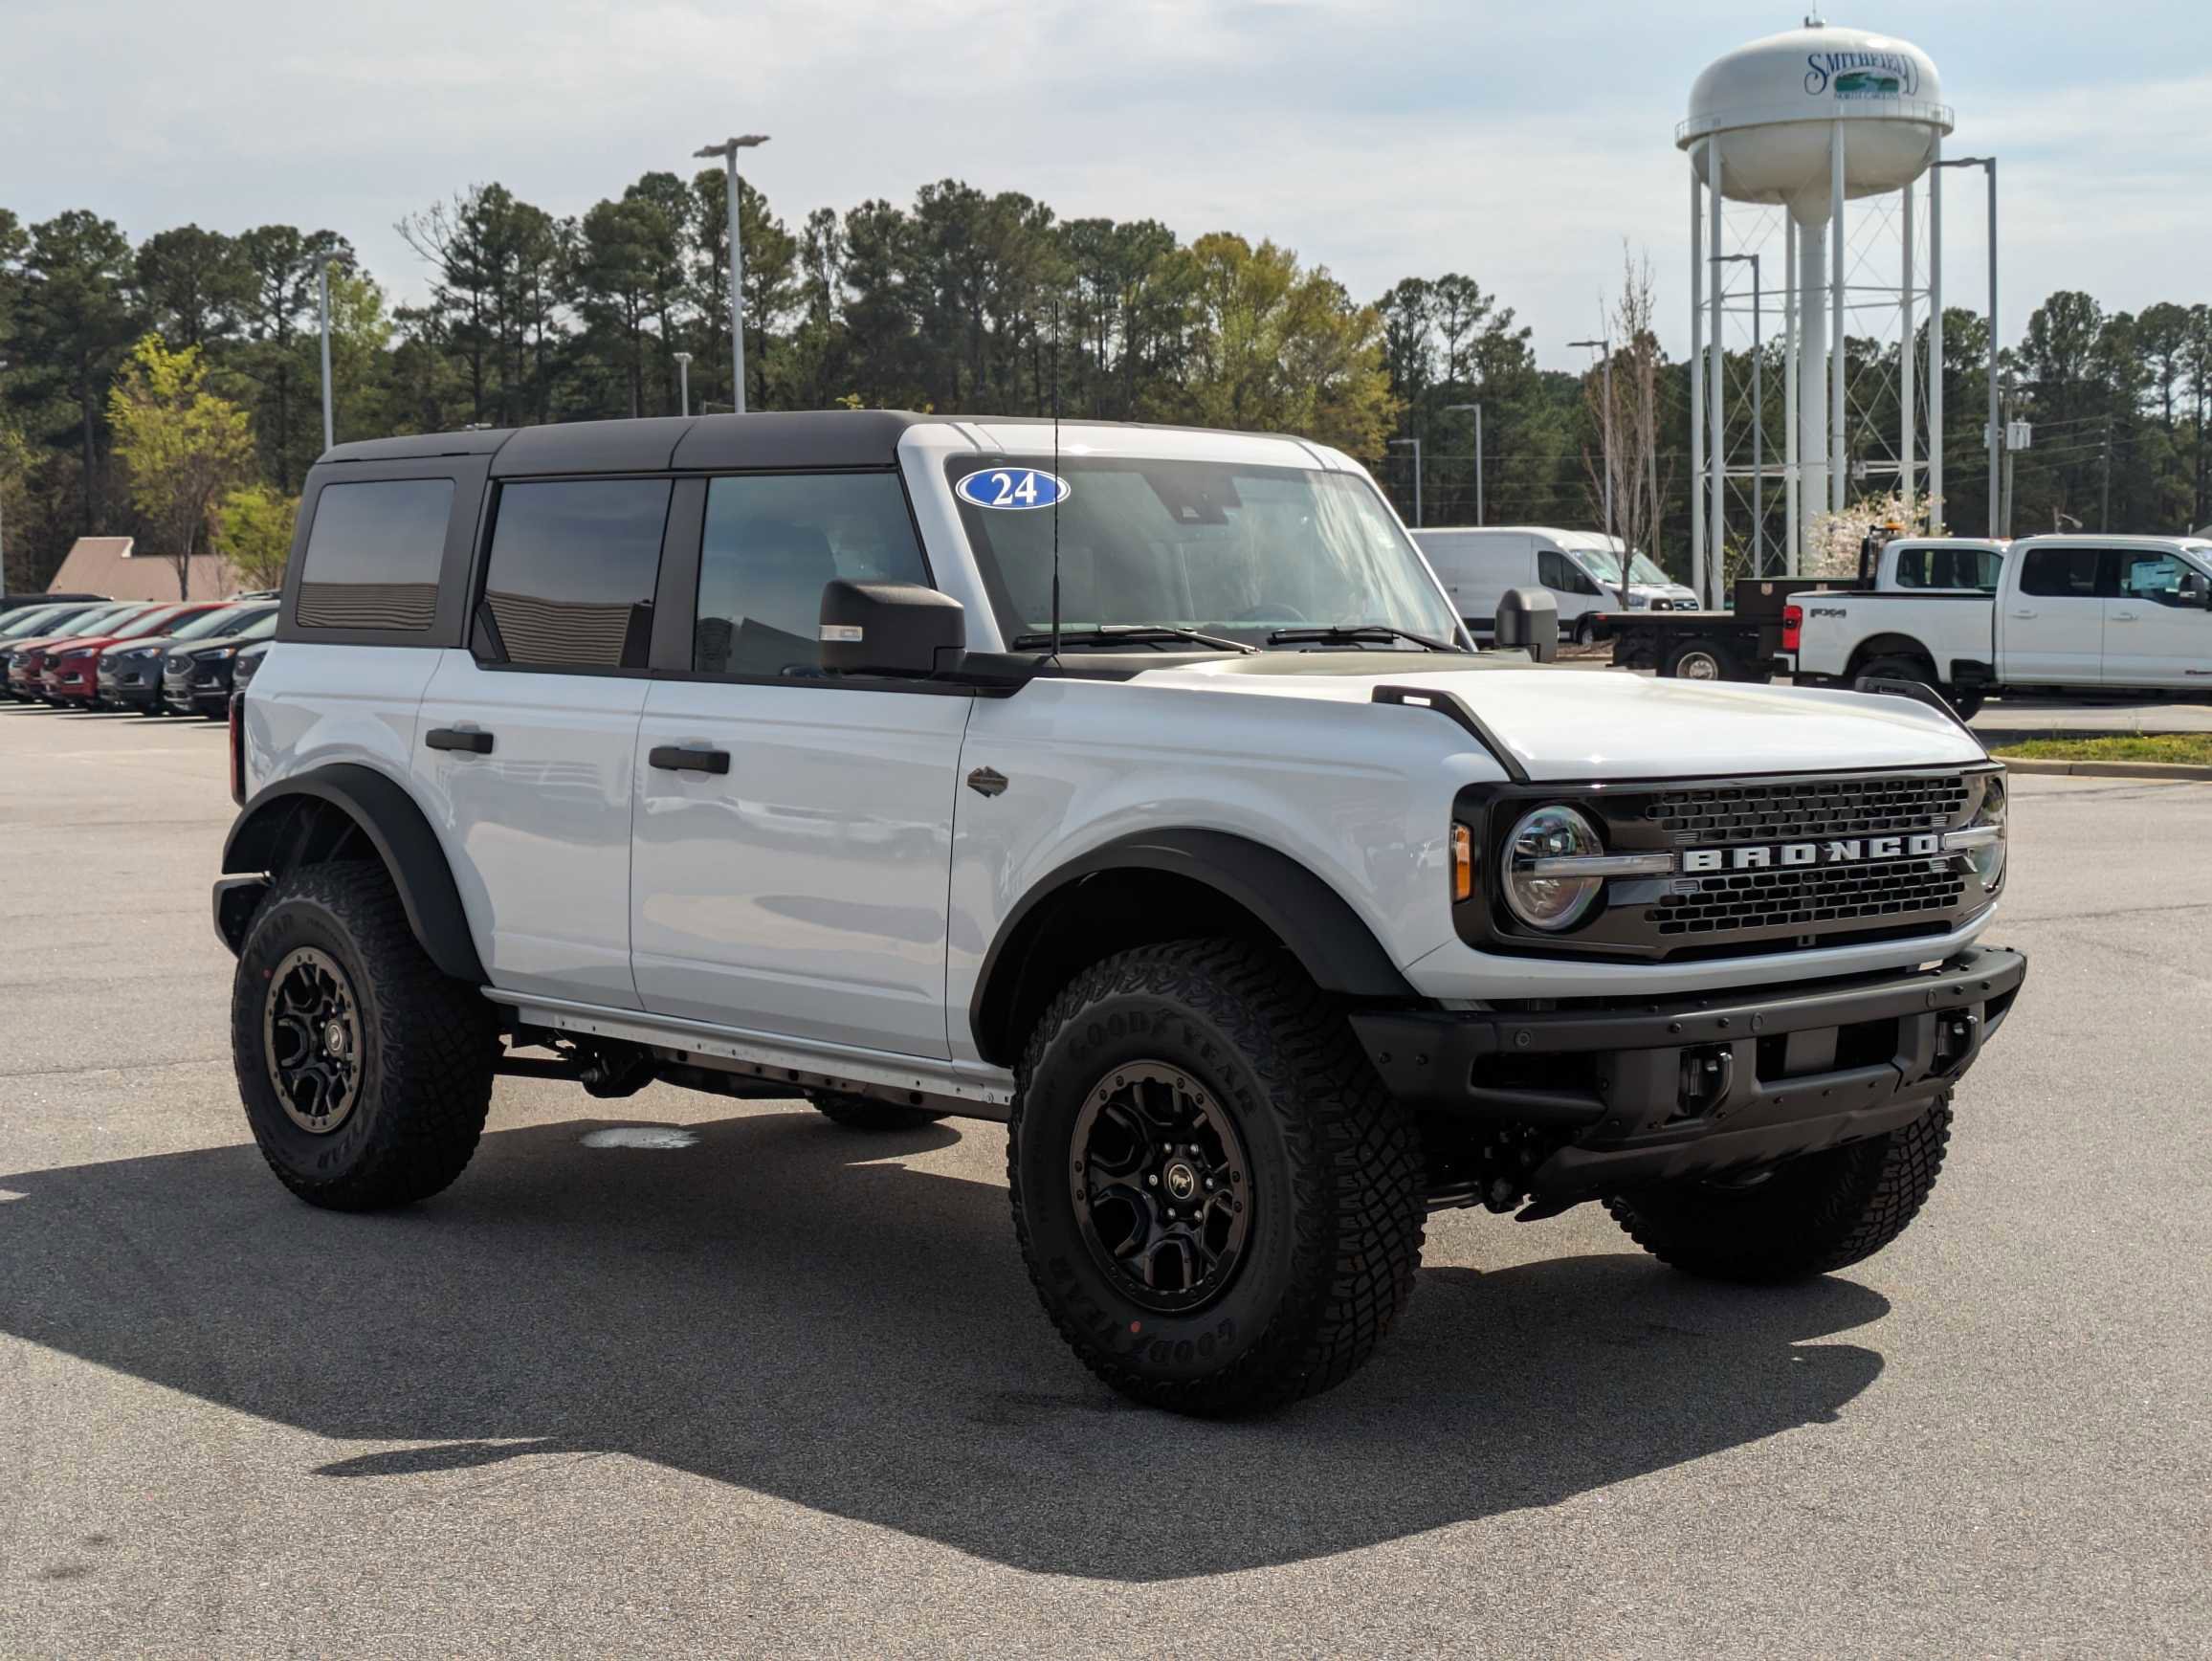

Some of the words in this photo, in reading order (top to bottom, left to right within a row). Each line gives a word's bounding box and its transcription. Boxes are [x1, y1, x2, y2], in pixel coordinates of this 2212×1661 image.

[1803, 53, 1919, 97] SMITHFIELD
[991, 472, 1037, 505] 24
[1682, 833, 1939, 873] BRONCO
